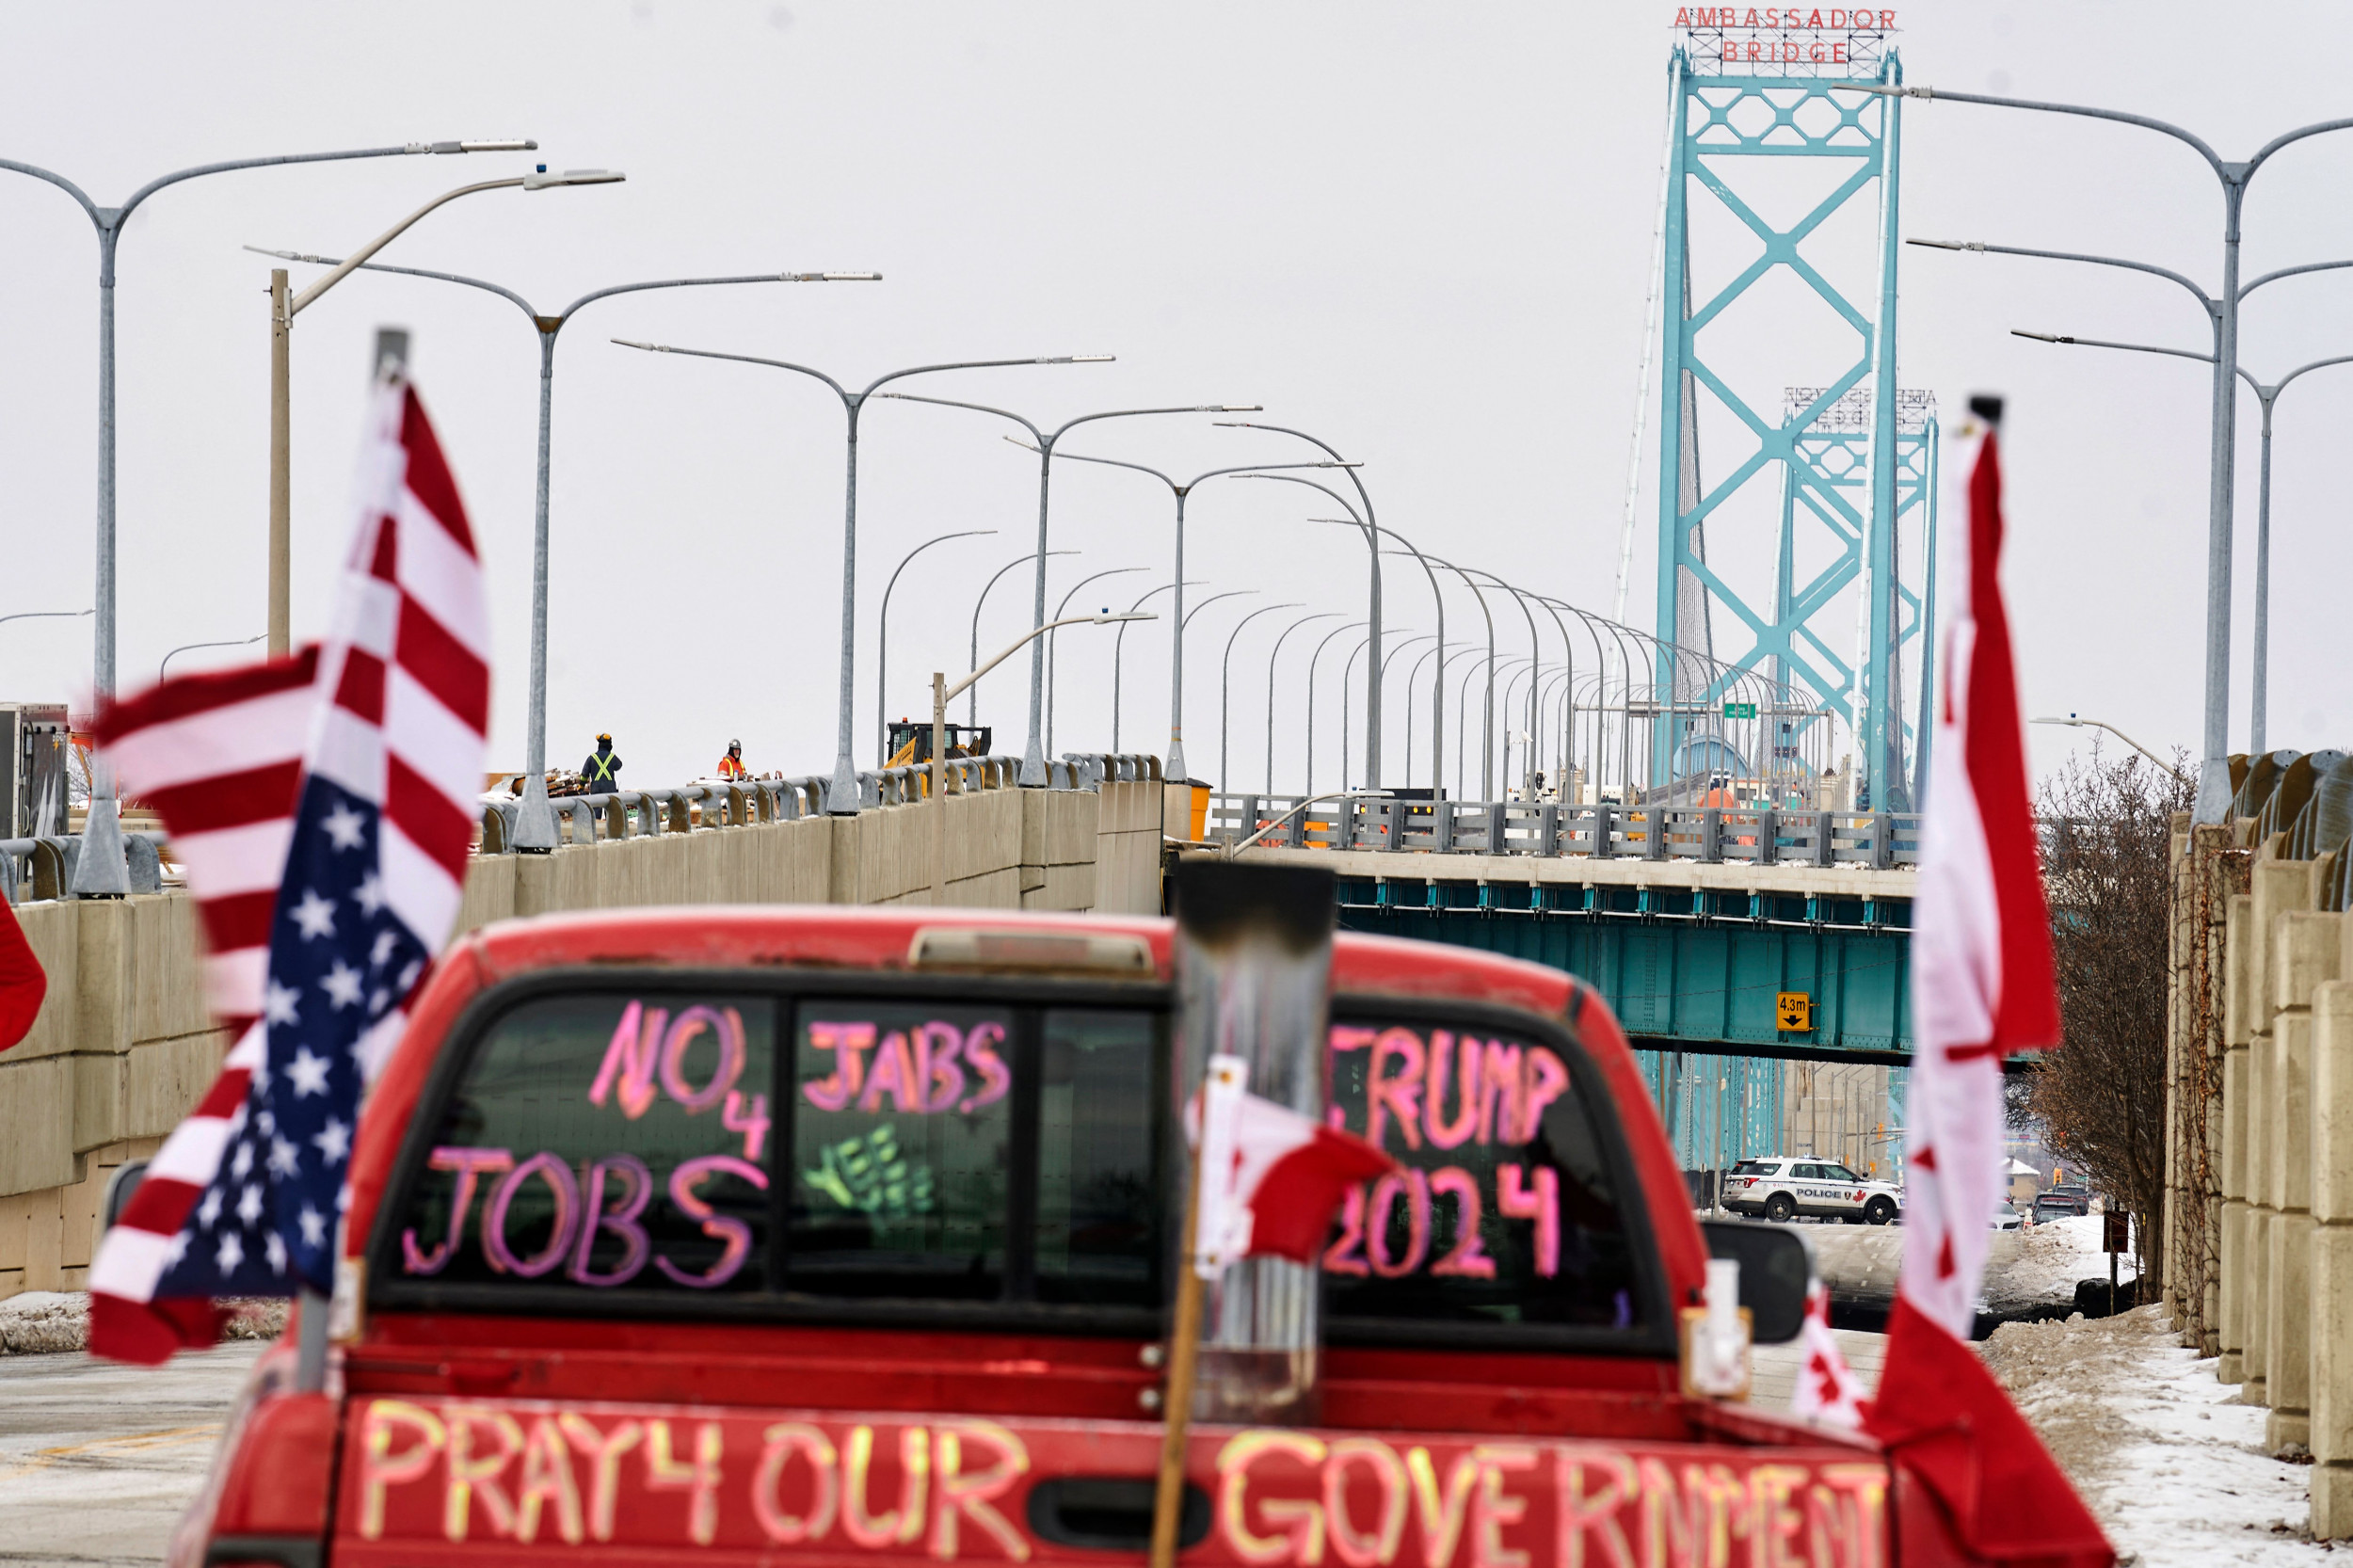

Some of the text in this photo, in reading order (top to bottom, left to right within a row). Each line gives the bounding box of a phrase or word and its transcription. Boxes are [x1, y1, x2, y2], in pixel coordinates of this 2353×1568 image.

[1674, 7, 1896, 29] AMBASSADOR
[1723, 41, 1848, 63] BRIDGE
[1780, 997, 1806, 1012] 4.3m
[588, 1000, 1012, 1120] NO JABS
[722, 1089, 771, 1161] 4
[1796, 1188, 1841, 1198] POLICE
[402, 1146, 771, 1288] JOBS
[359, 1399, 1890, 1568] PRAY 4 OUR GOVERNMENT
